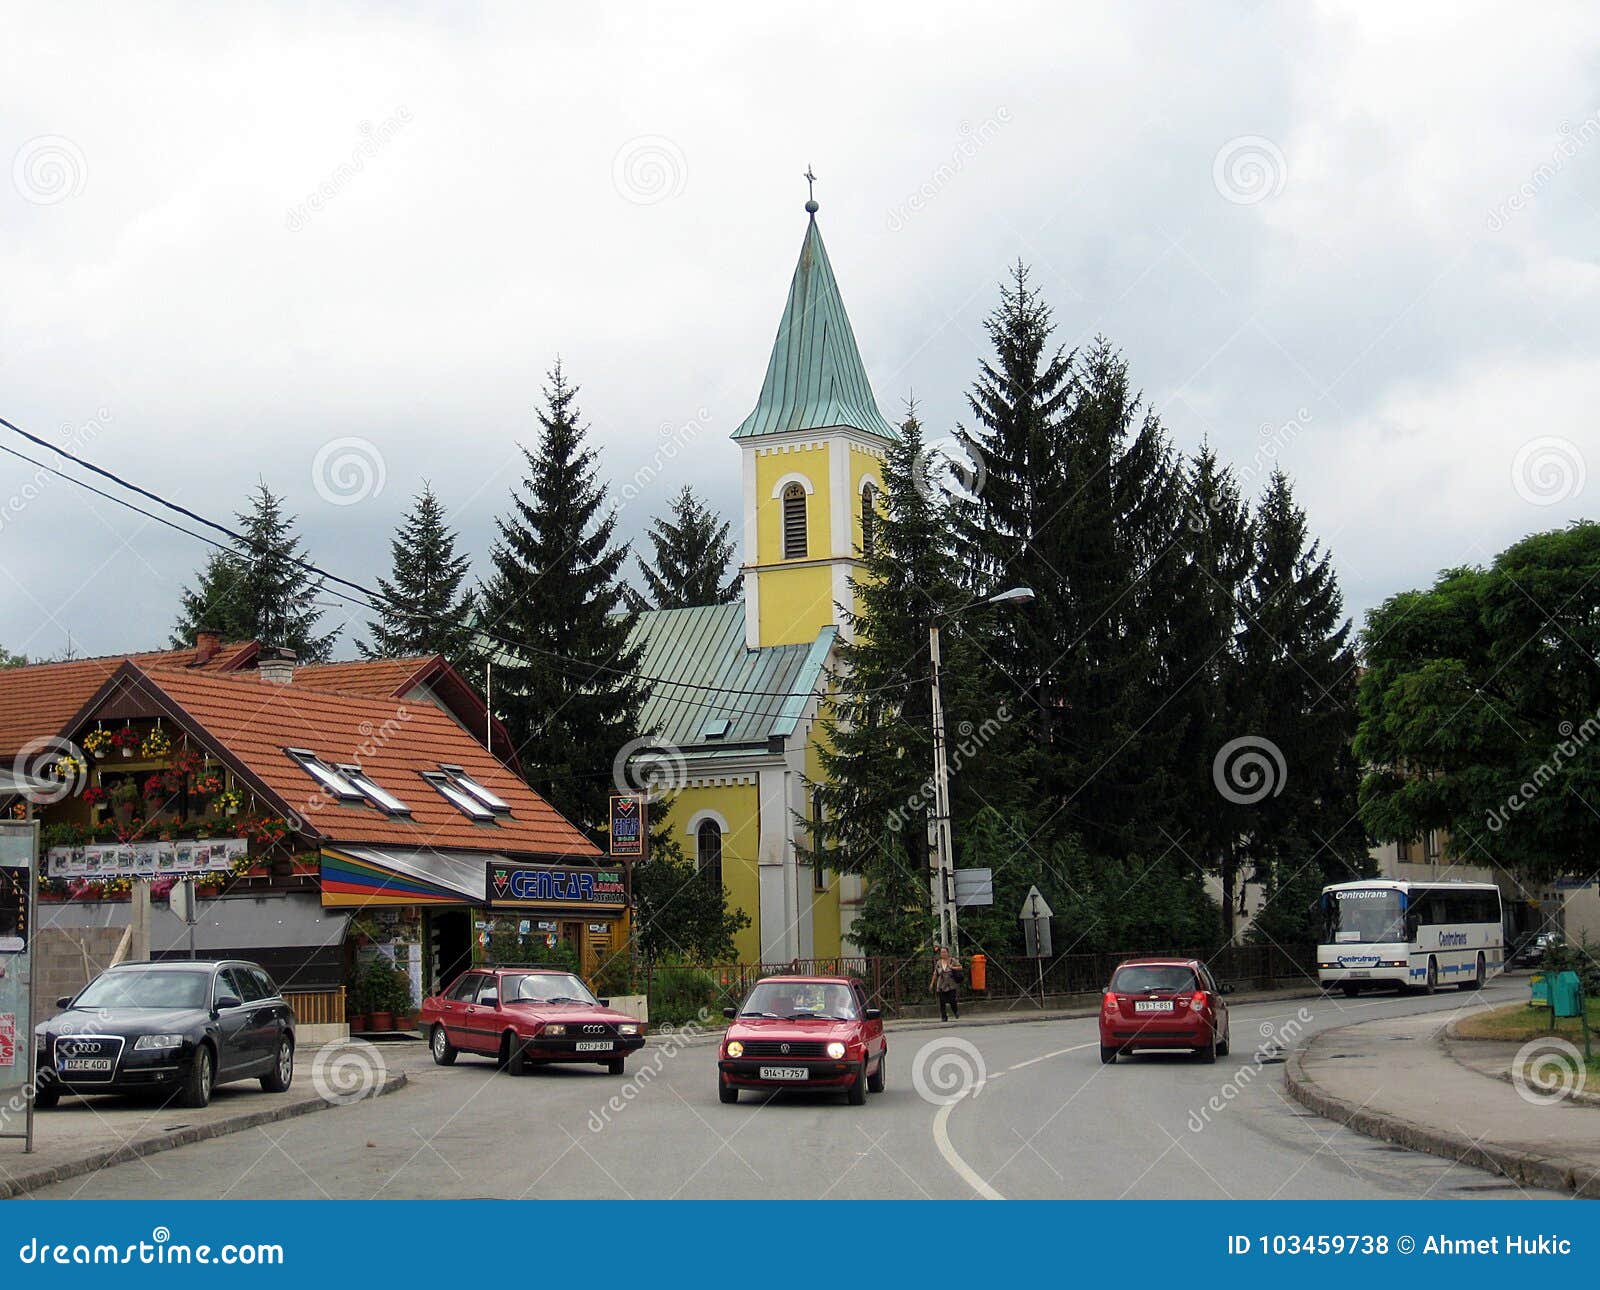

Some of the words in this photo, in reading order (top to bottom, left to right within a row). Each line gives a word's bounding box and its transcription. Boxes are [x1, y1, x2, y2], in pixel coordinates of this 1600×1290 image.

[510, 870, 594, 900] CENTAR
[1335, 891, 1388, 900] Centrotrans
[763, 1068, 806, 1078] 914-T-757
